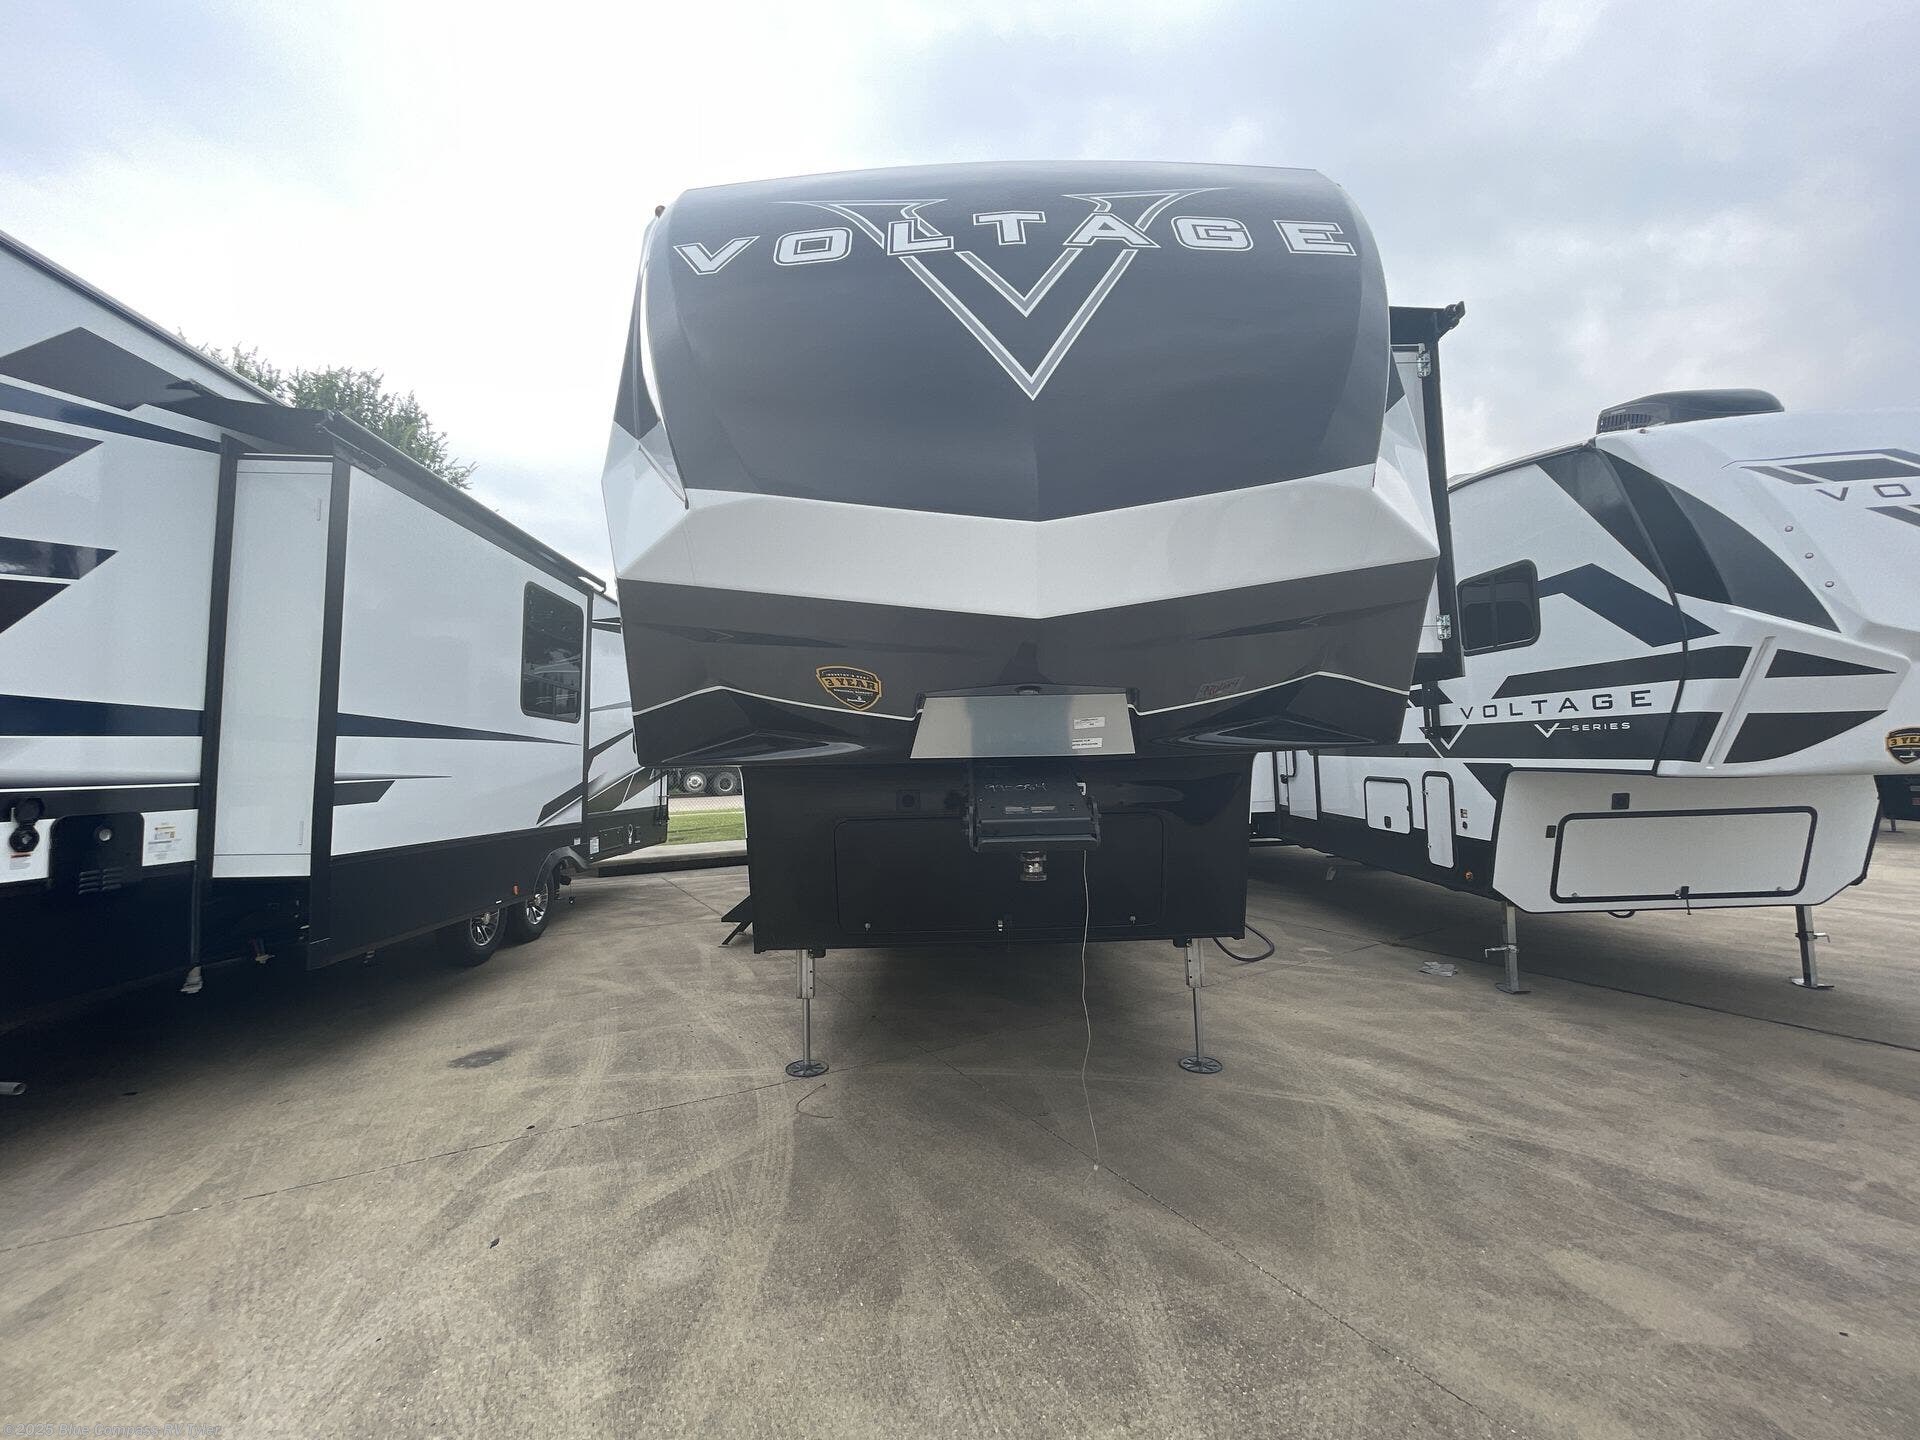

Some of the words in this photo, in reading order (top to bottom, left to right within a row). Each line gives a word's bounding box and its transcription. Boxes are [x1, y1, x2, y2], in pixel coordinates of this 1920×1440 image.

[673, 210, 1358, 275] VOLTAGE
[825, 678, 835, 687] 3
[836, 678, 876, 690] YEAR
[1460, 689, 1652, 719] VOLTAGE
[1901, 736, 1920, 744] YE
